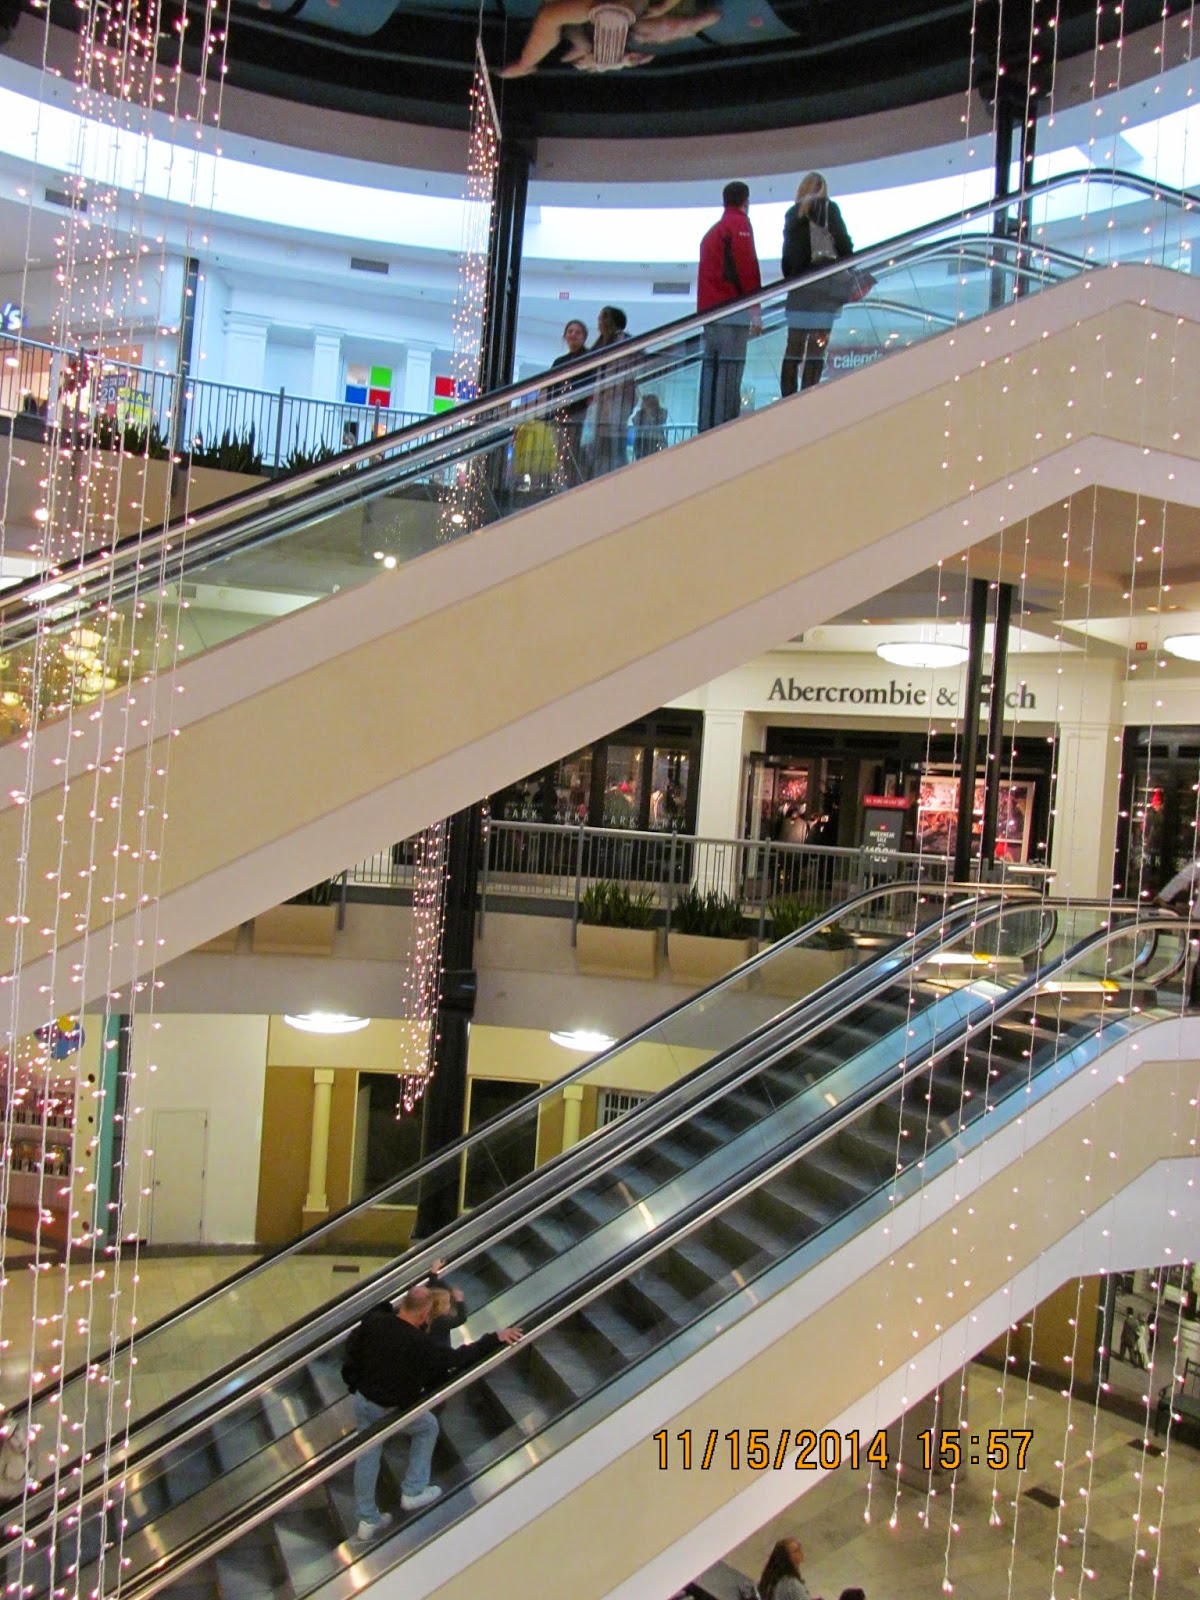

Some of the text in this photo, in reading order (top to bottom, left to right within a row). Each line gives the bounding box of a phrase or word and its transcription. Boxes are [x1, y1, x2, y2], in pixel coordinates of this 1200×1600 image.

[833, 350, 883, 369] calend
[768, 677, 927, 705] Abercrombie
[936, 687, 958, 706] &
